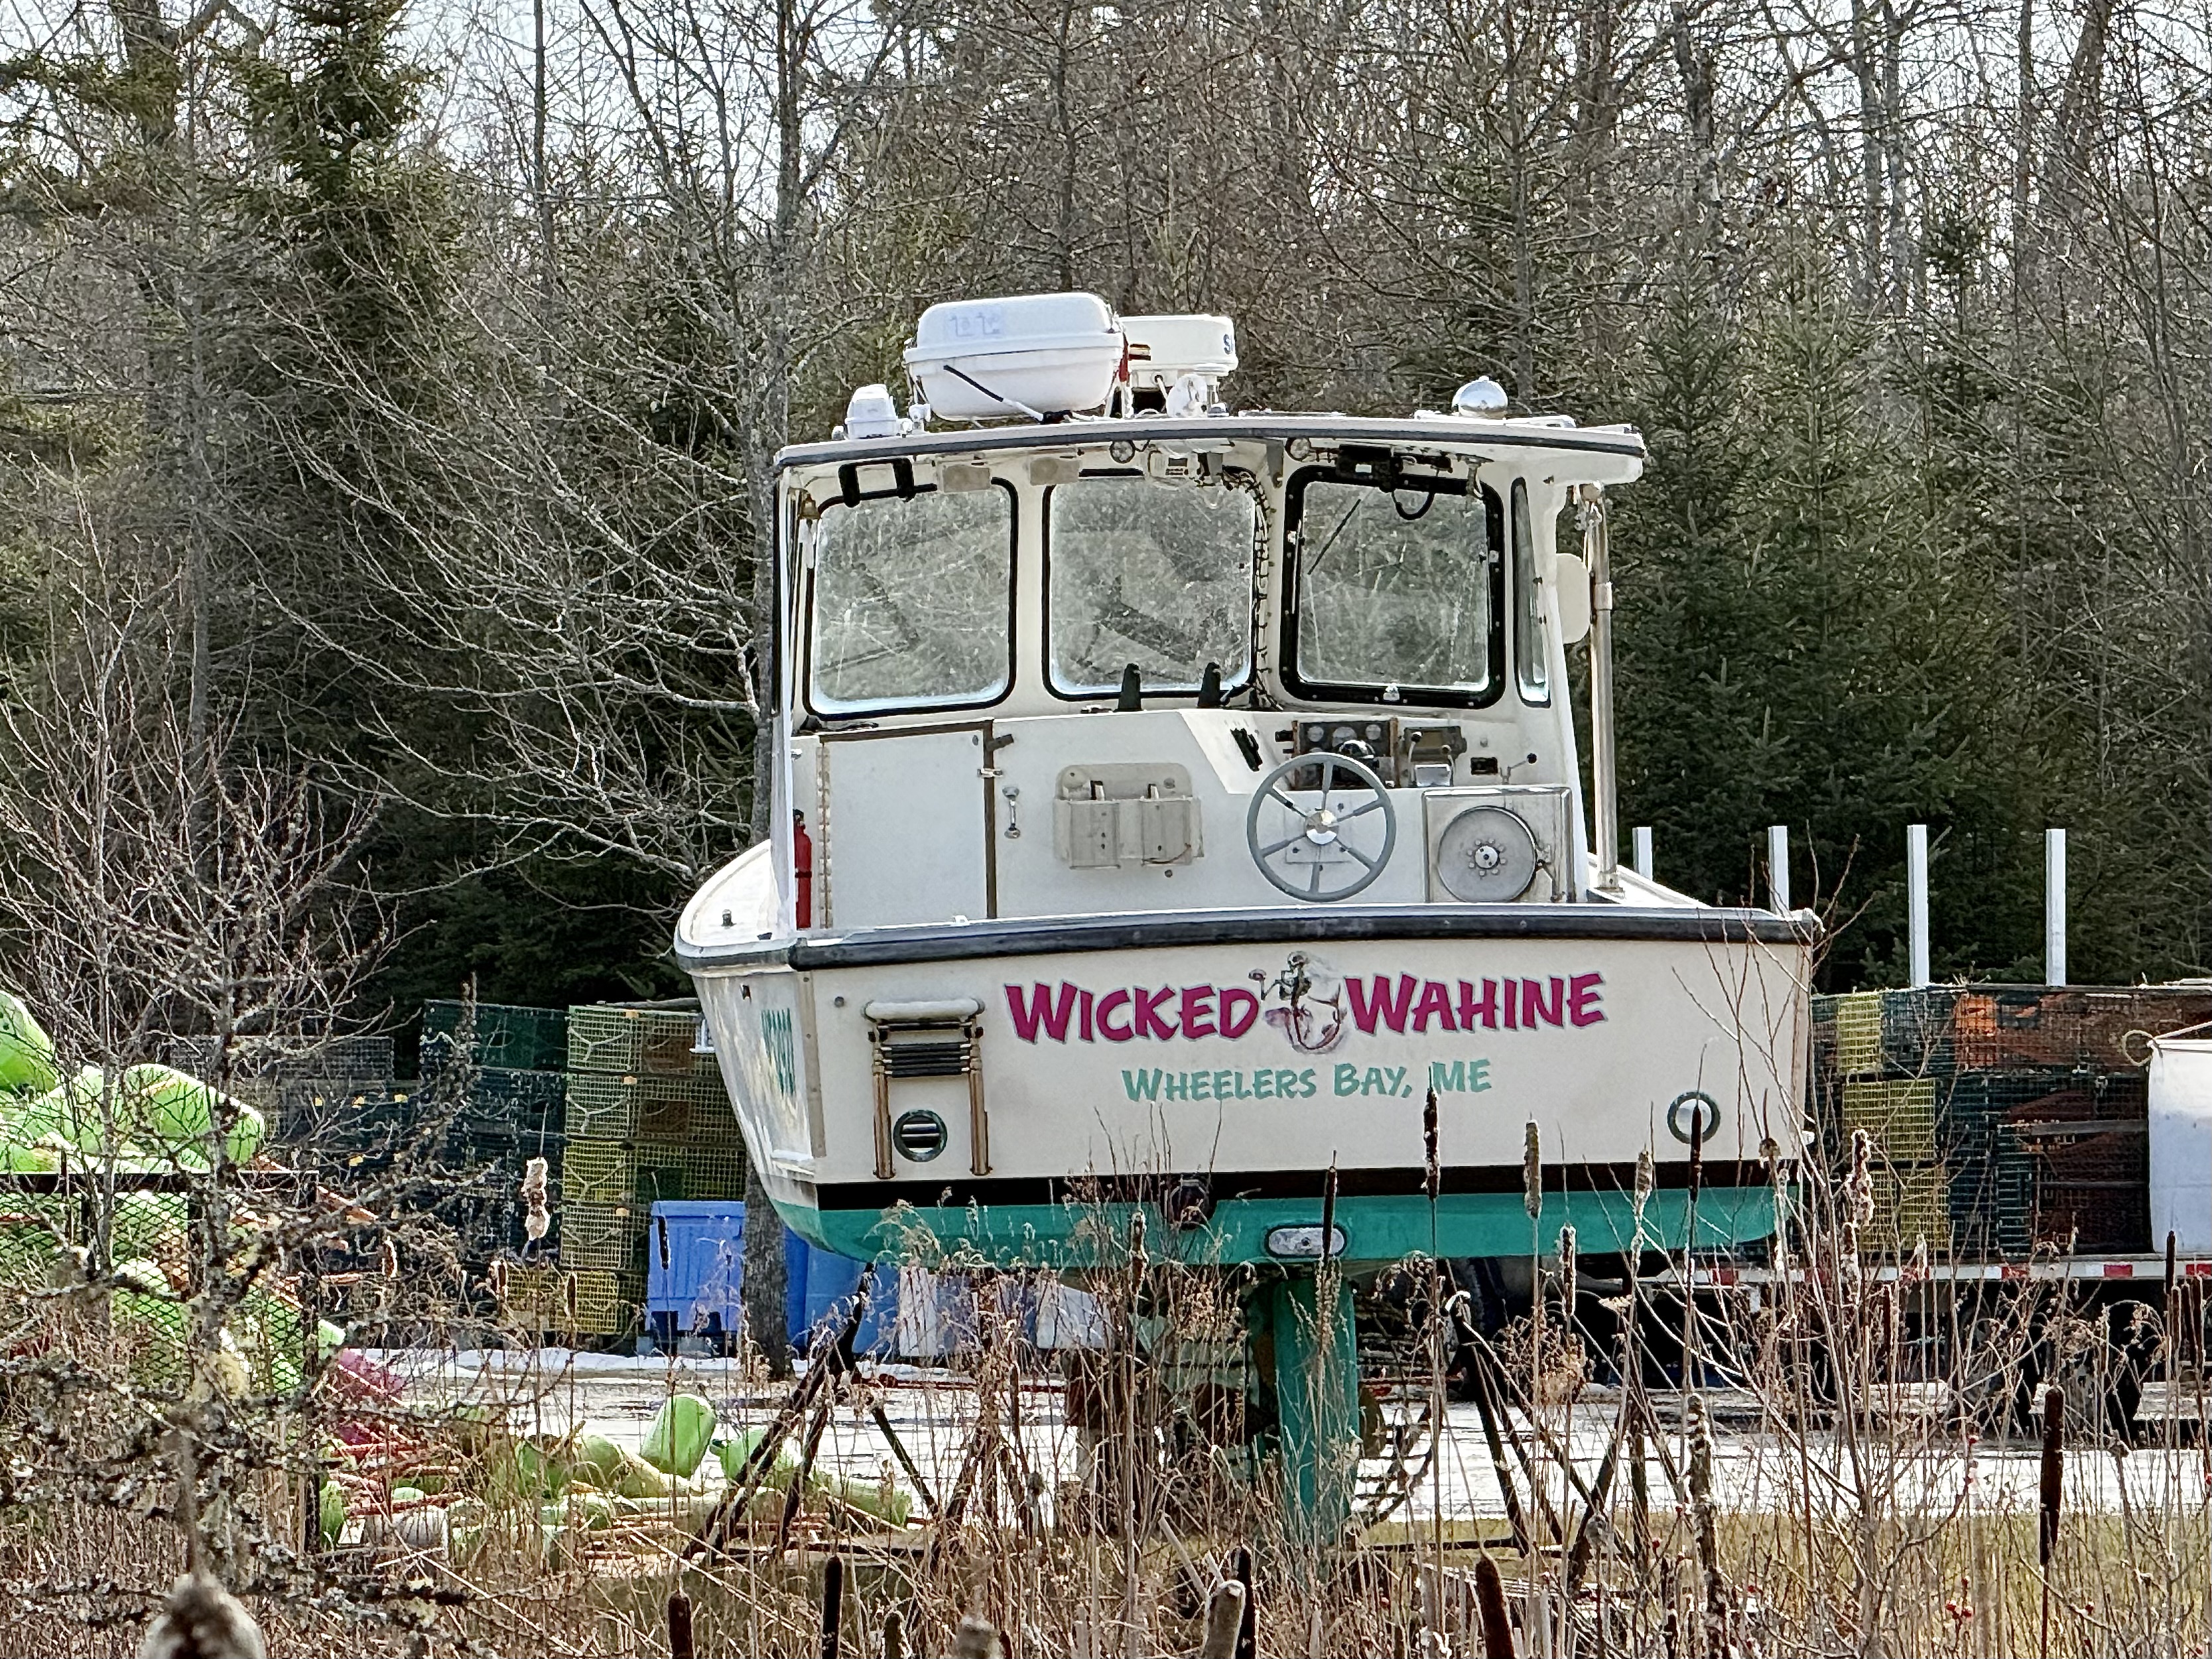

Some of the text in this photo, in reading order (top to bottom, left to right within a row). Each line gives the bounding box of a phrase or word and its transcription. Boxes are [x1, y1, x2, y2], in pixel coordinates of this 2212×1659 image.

[1005, 973, 1606, 1043] WICKED WAHINE
[1122, 1059, 1491, 1100] WHEELERS BAY, ME
